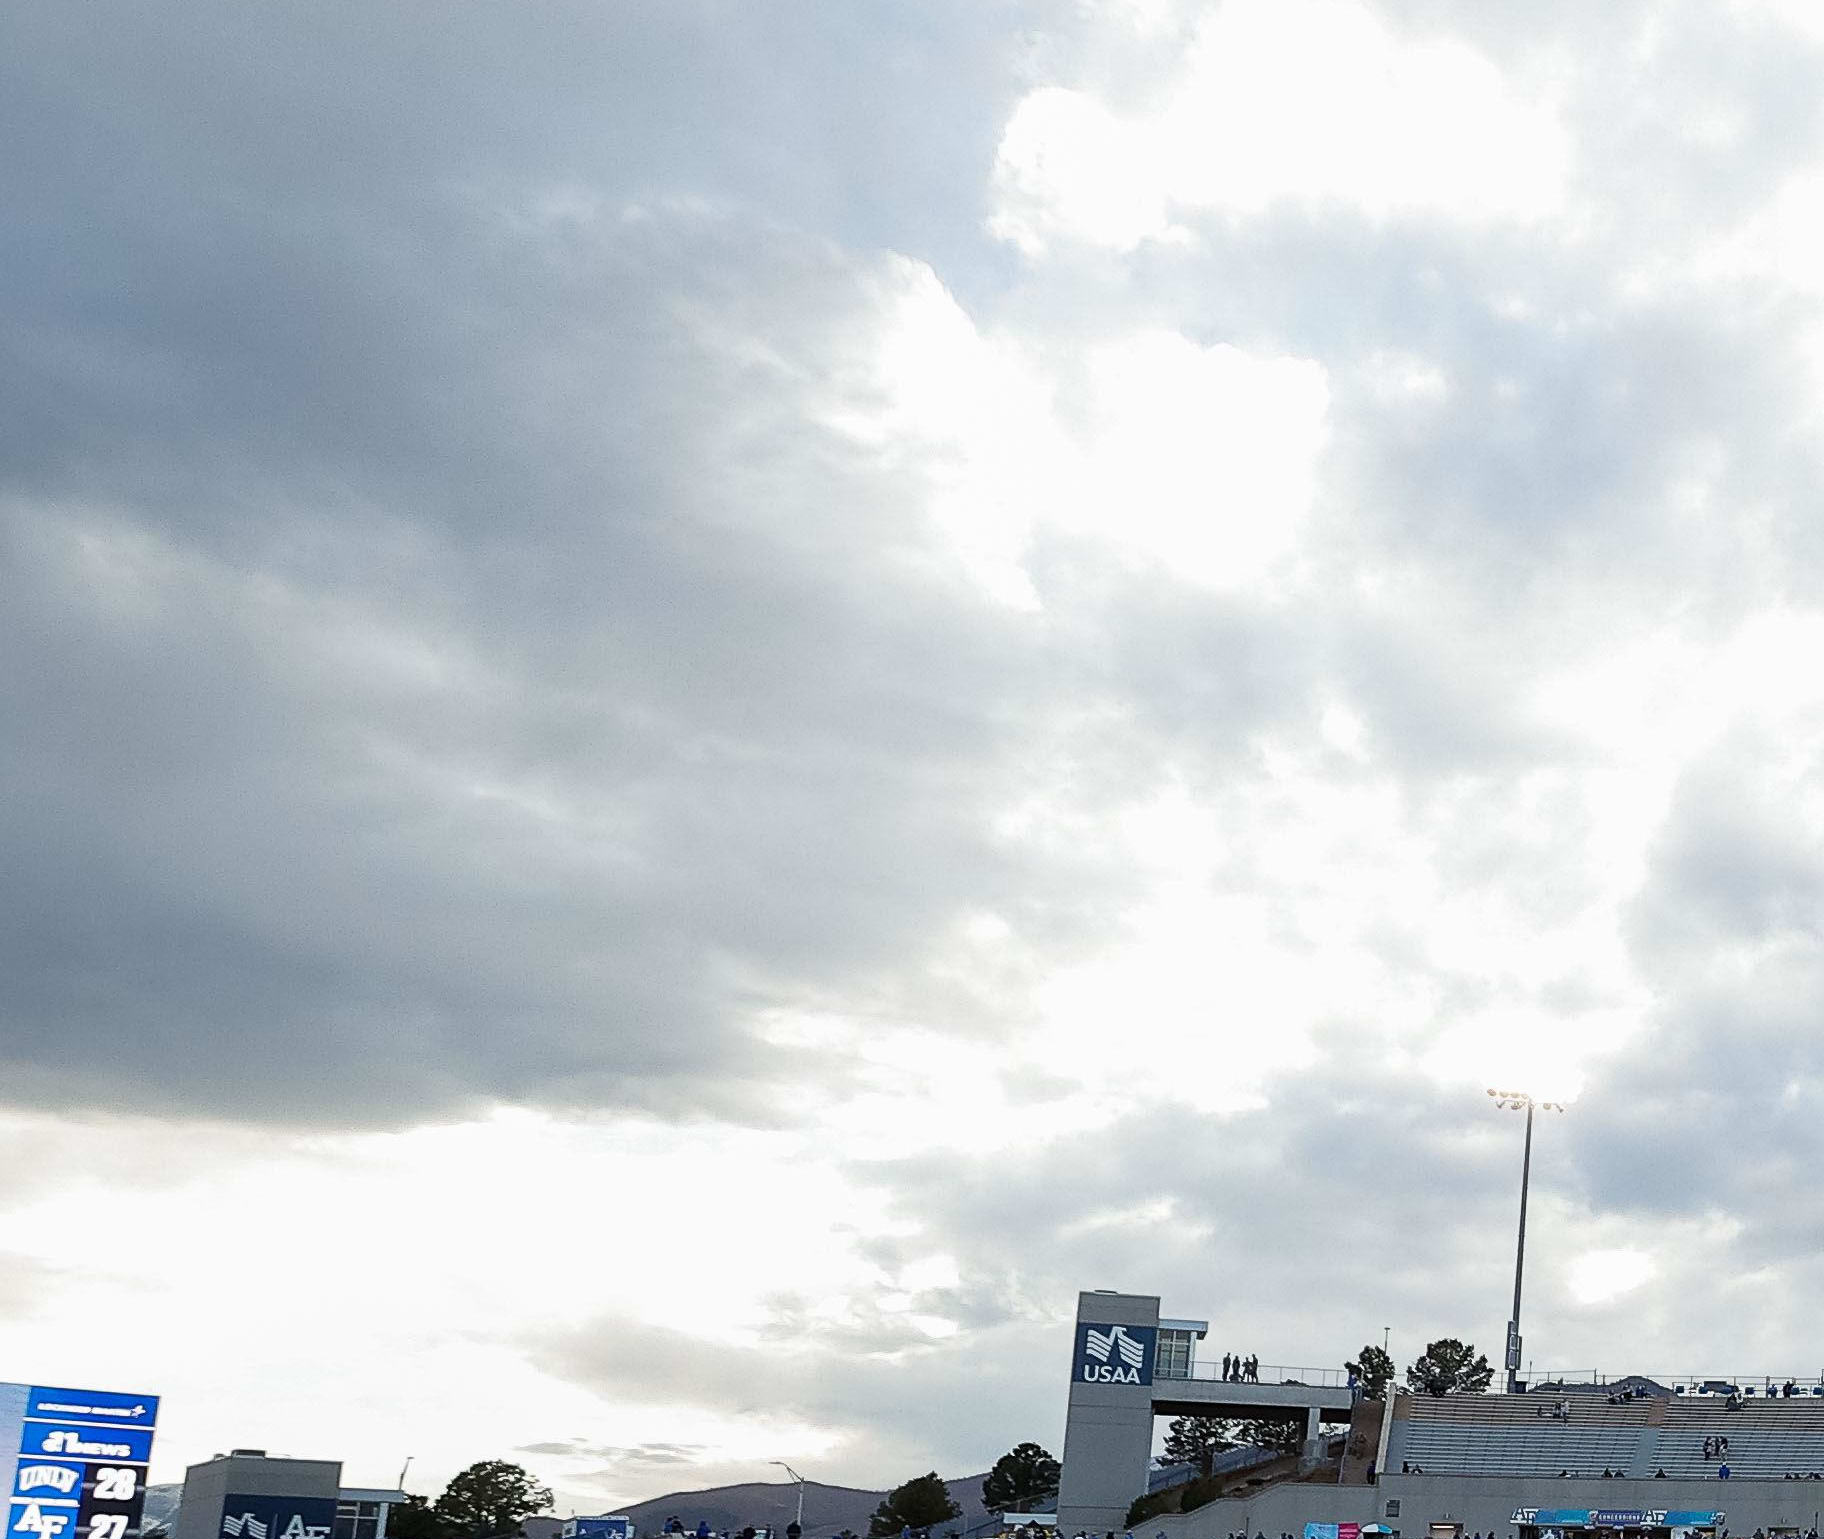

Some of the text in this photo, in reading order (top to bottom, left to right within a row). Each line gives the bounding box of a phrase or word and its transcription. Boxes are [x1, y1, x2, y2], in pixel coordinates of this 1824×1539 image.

[1084, 1365, 1140, 1384] USAA
[19, 1465, 136, 1500] UNLV 28
